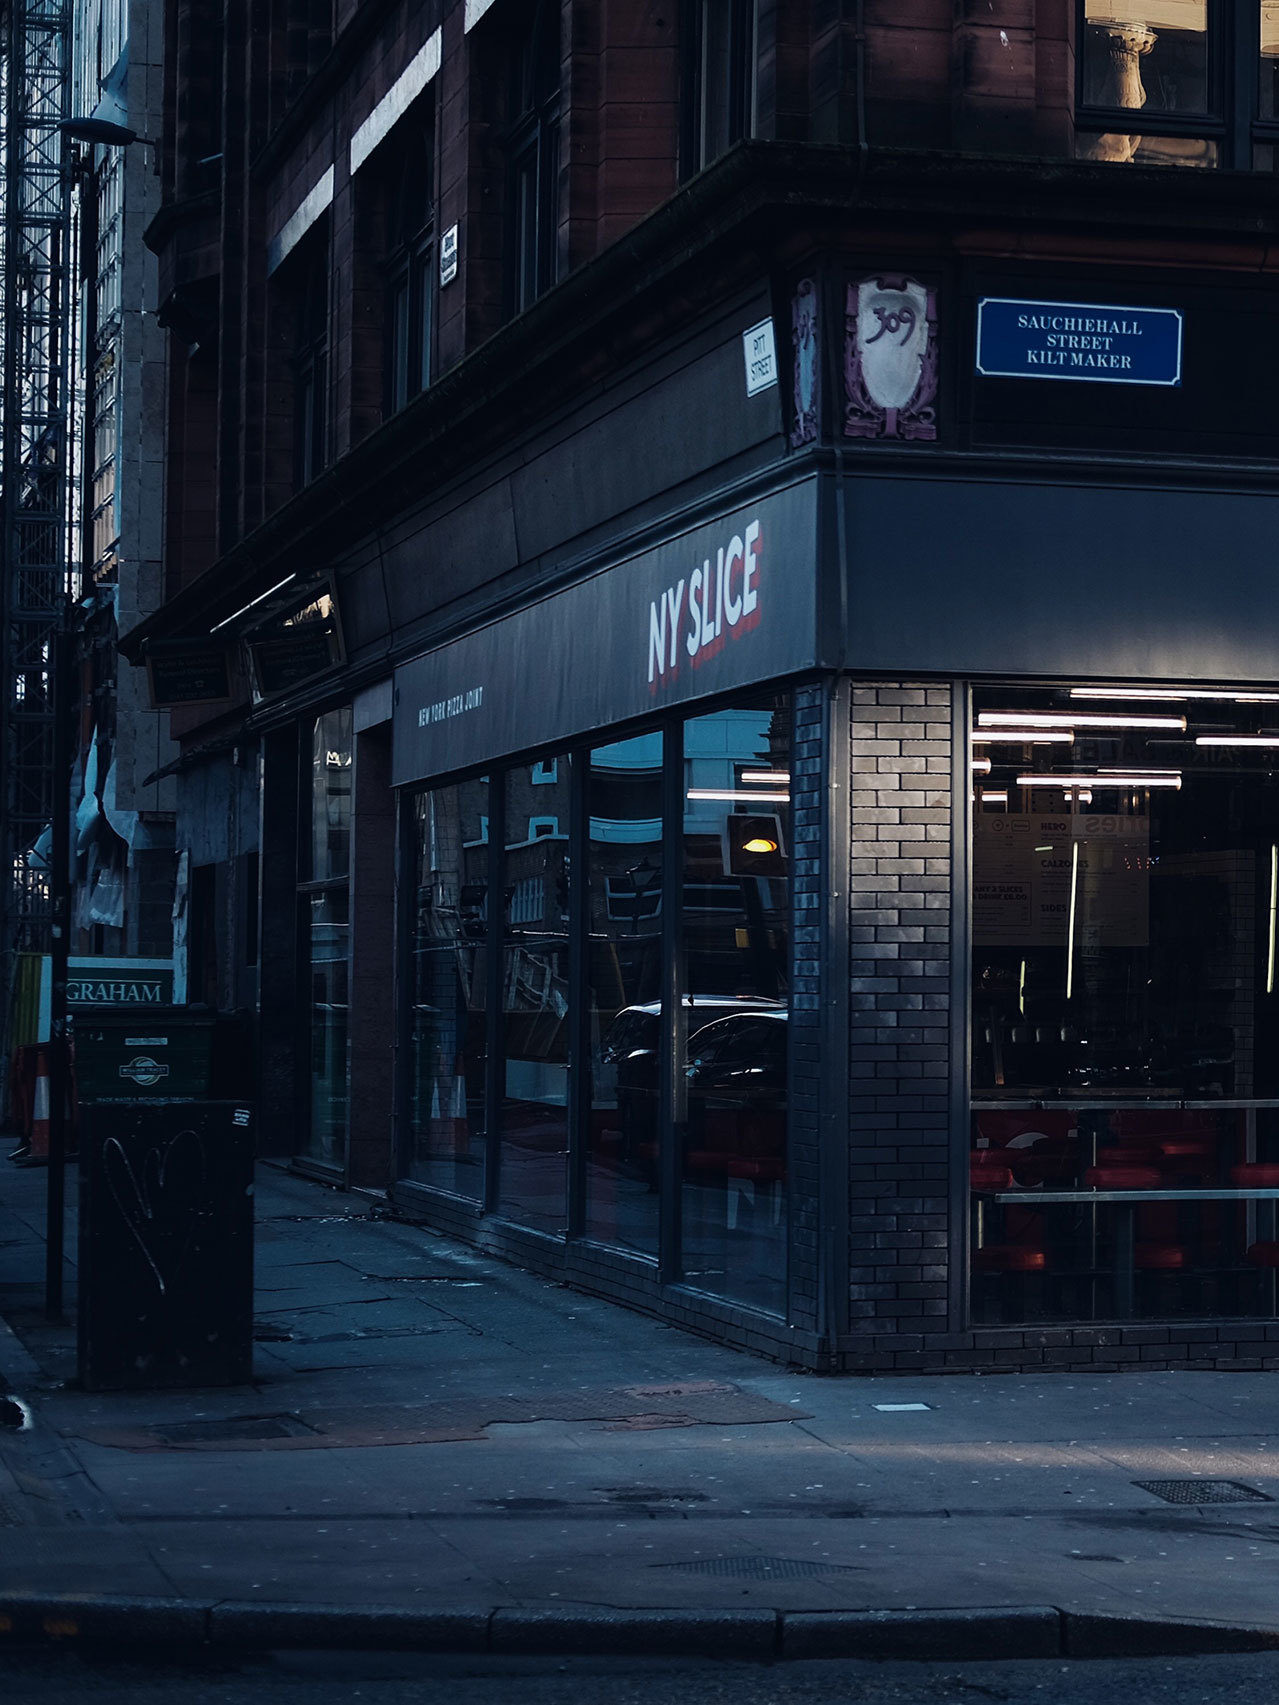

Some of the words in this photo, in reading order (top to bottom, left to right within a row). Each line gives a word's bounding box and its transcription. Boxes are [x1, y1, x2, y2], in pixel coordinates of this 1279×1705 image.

[865, 306, 916, 346] 309
[1018, 315, 1143, 335] SAUCHIEHALL
[1047, 334, 1113, 350] STREET
[751, 354, 771, 381] STREET
[648, 578, 687, 684] NY
[686, 519, 761, 660] SLICE
[66, 982, 162, 1002] GRAHAM
